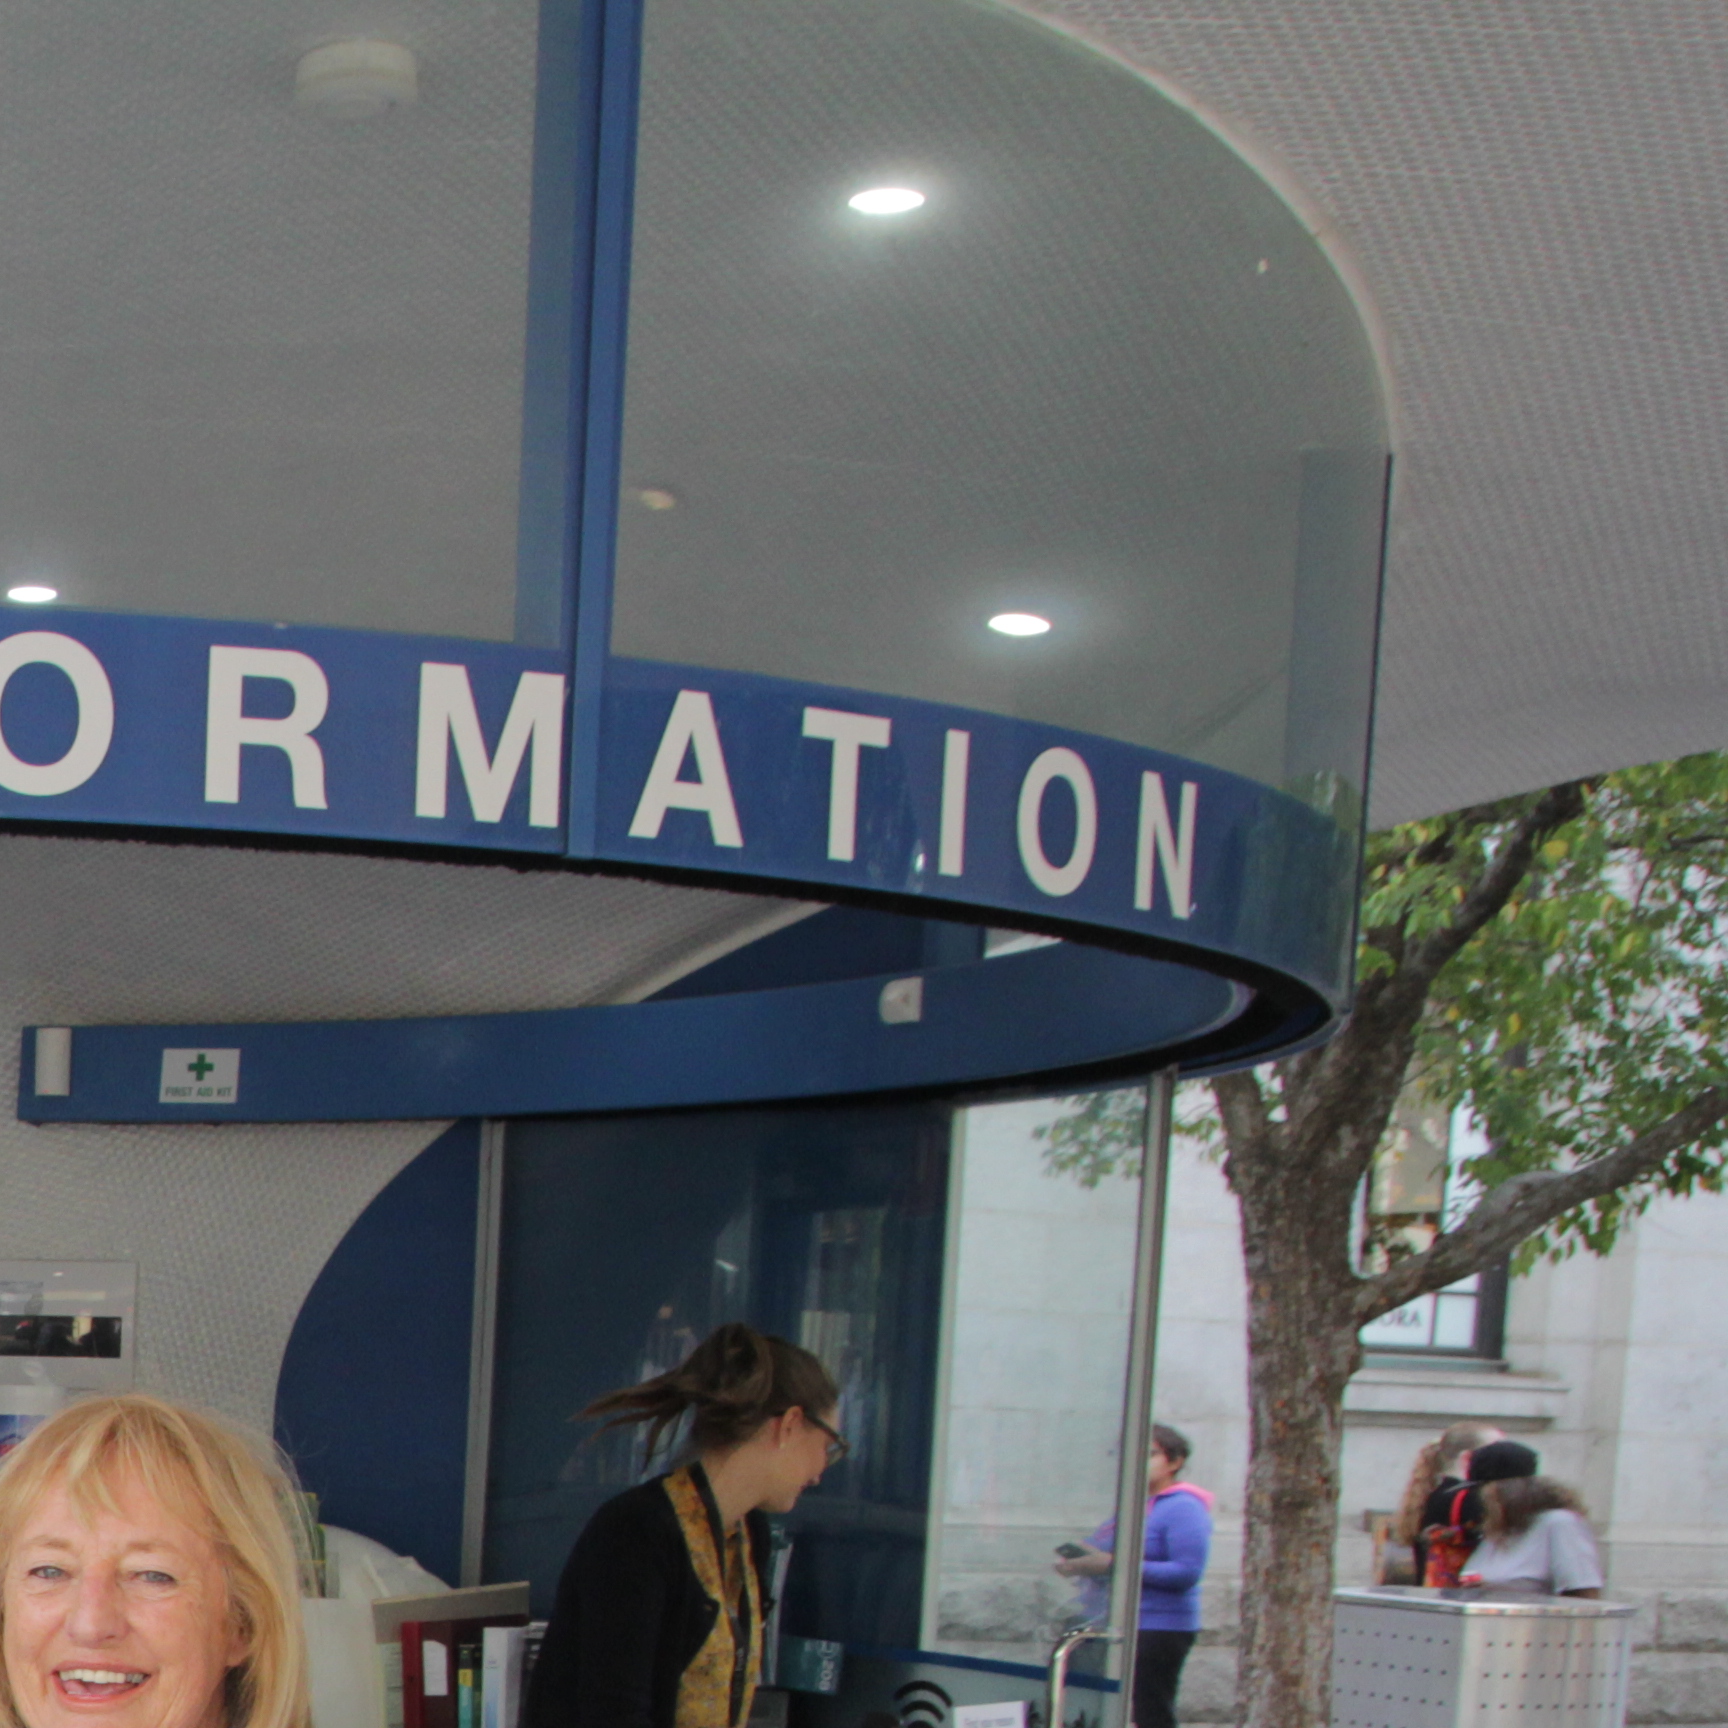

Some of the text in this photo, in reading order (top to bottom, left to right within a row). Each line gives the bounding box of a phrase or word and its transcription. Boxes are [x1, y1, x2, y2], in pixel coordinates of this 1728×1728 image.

[165, 1086, 233, 1097] FIRST AID KIT
